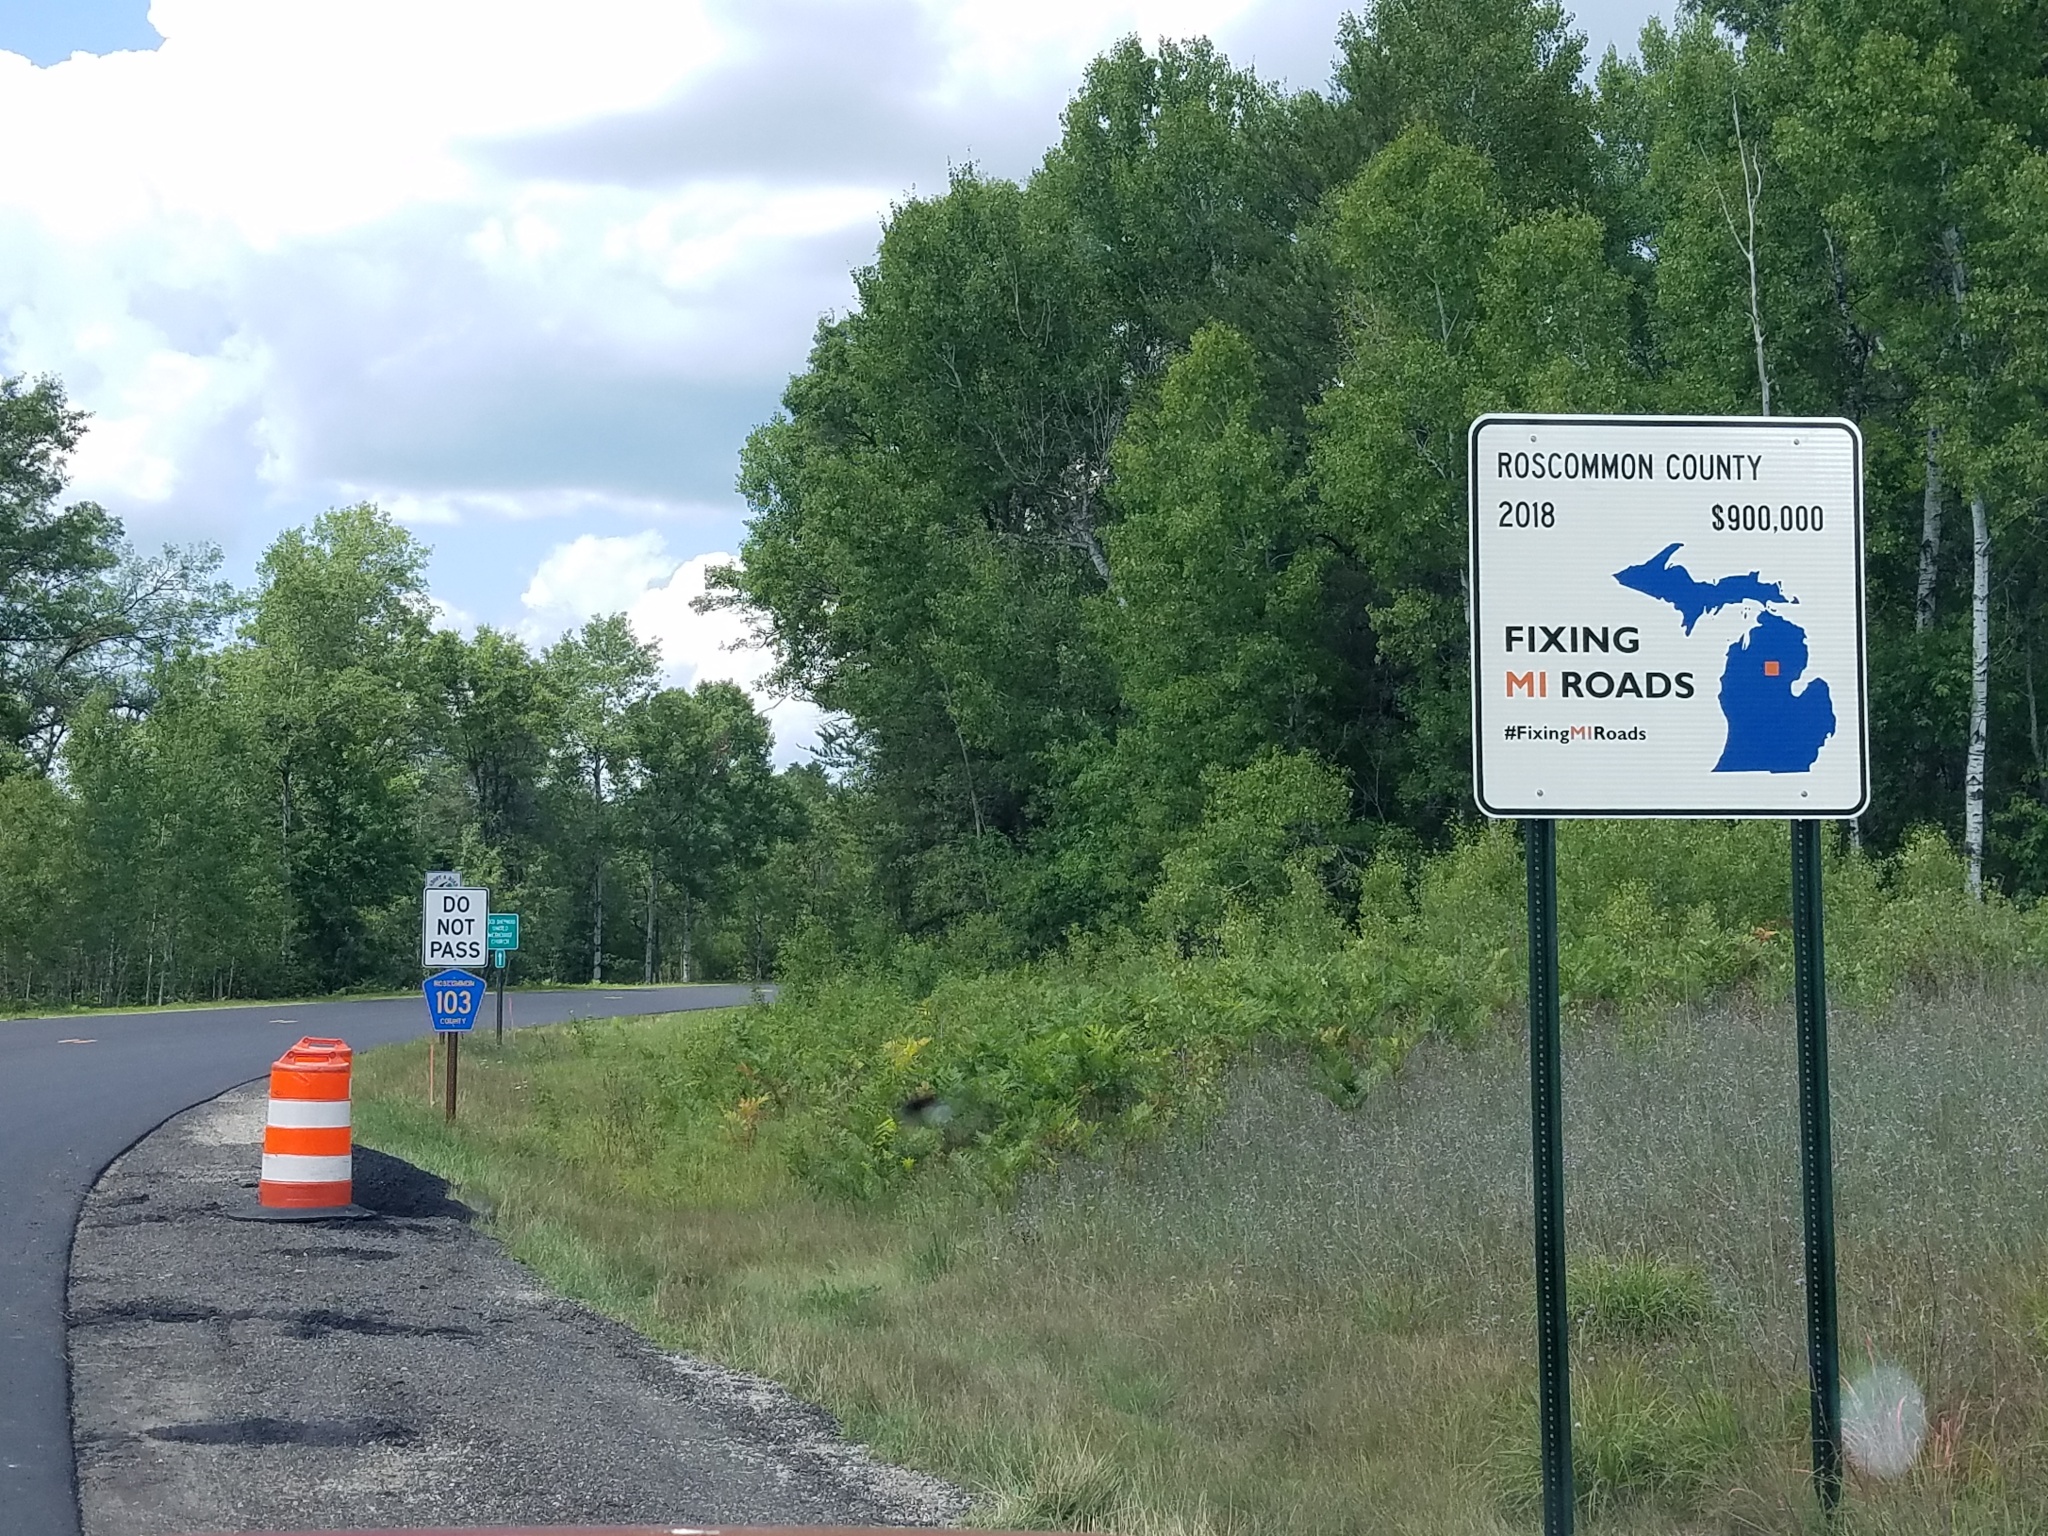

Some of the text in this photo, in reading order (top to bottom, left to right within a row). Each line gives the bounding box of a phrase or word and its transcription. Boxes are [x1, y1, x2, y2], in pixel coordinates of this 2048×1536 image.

[1498, 451, 1762, 481] ROSCOMMON COUNTY
[1498, 501, 1824, 534] 2018 $900,000
[1505, 626, 1640, 654] FIXING
[1506, 671, 1695, 699] MI ROADS
[1504, 725, 1647, 744] #FixingMIRoads
[443, 896, 470, 913] DO
[437, 919, 475, 935] NOT
[430, 941, 481, 958] PASS
[436, 990, 471, 1014] 103
